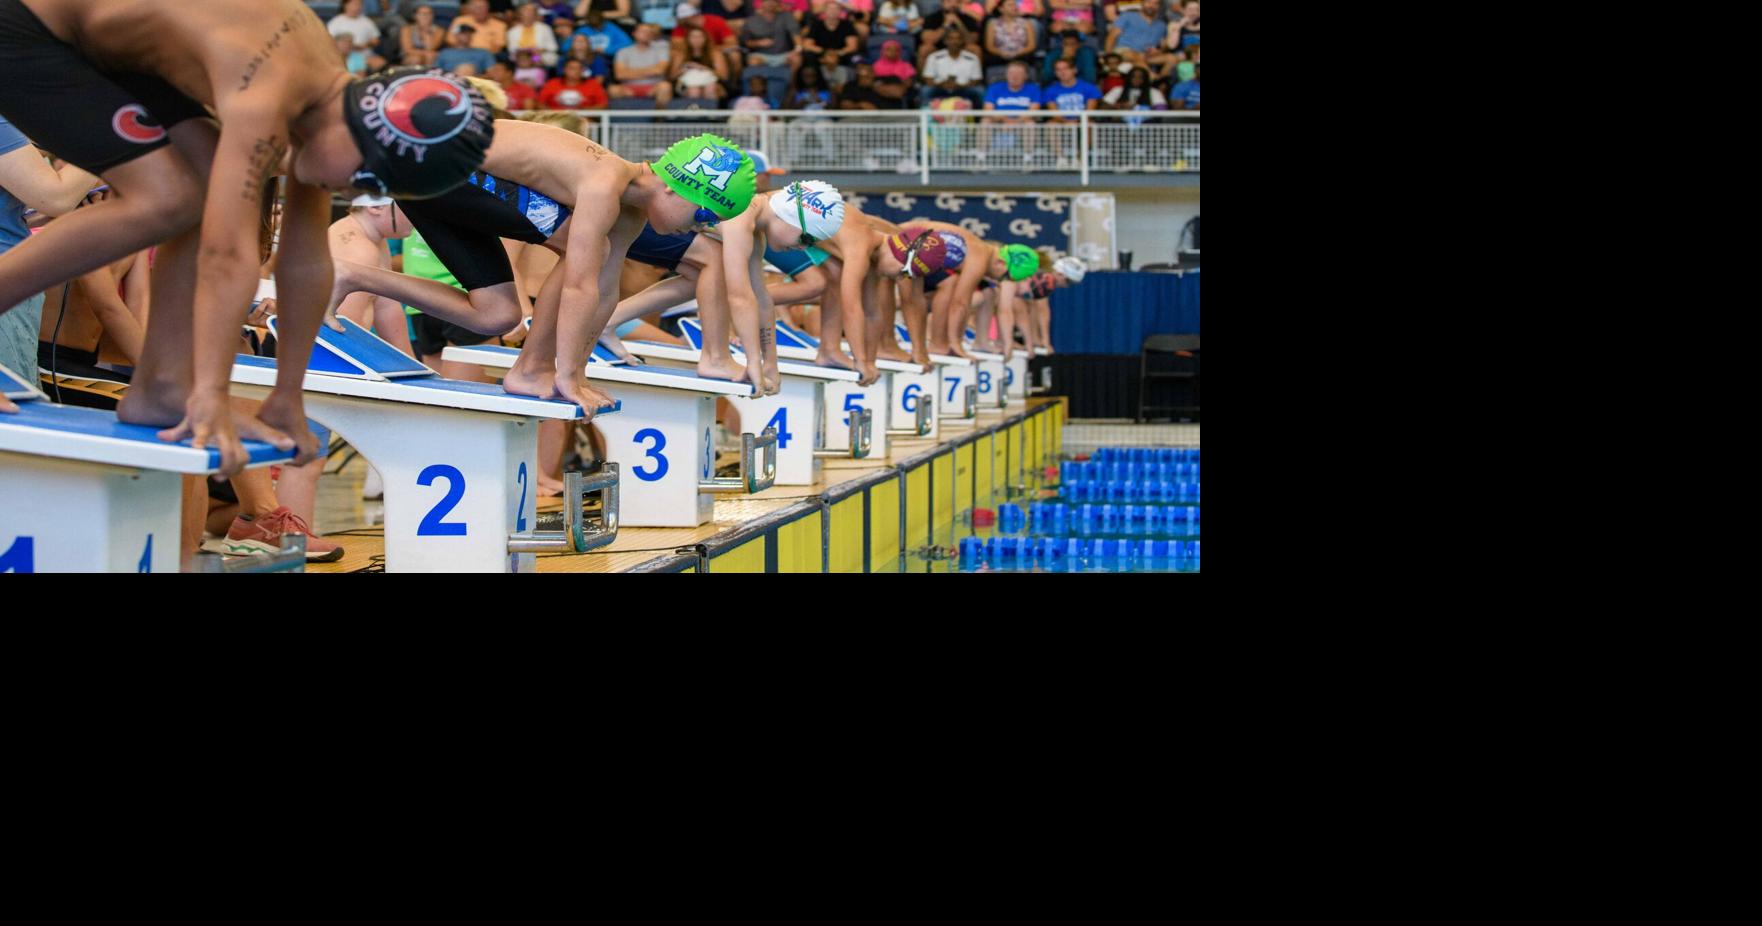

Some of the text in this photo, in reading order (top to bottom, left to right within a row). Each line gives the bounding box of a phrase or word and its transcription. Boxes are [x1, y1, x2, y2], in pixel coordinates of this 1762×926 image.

[360, 82, 428, 163] COUNTY
[664, 162, 736, 210] COUNTY TEAM
[785, 185, 837, 219] SARK
[902, 384, 923, 413] 6
[944, 377, 961, 402] 7
[978, 371, 992, 394] 8
[760, 407, 792, 449] 4
[842, 393, 865, 427] 5
[632, 427, 669, 482] 3
[703, 426, 711, 480] 3
[416, 464, 467, 536] 2
[516, 461, 528, 534] 2
